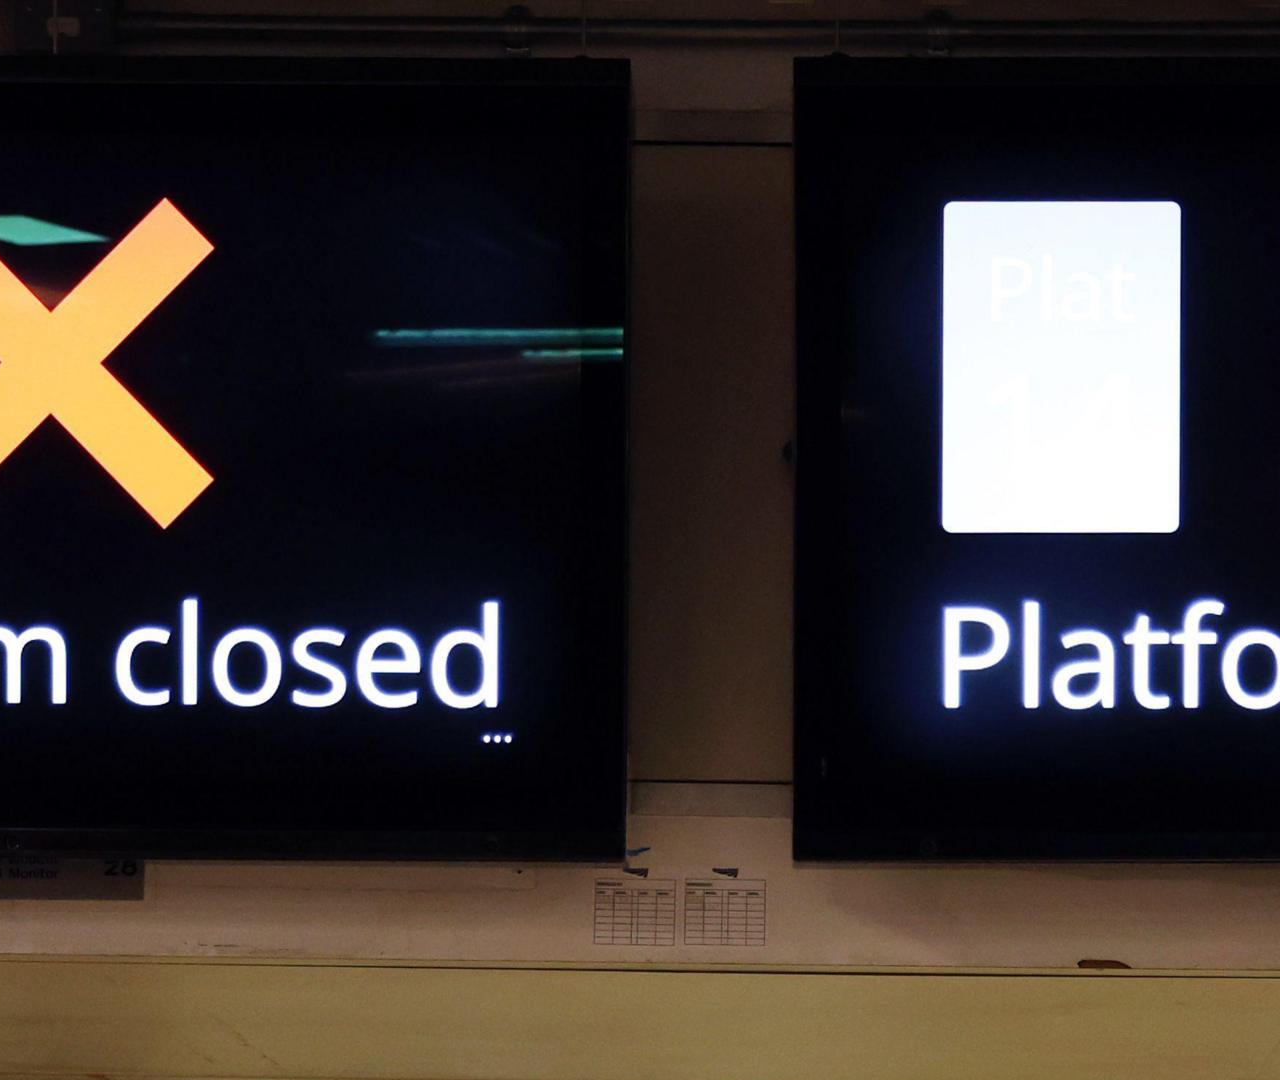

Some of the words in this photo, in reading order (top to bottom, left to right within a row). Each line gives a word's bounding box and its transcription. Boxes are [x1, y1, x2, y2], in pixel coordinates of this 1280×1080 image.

[990, 252, 1137, 321] Plat
[114, 597, 500, 710] closed
[9, 867, 59, 880] Monitor
